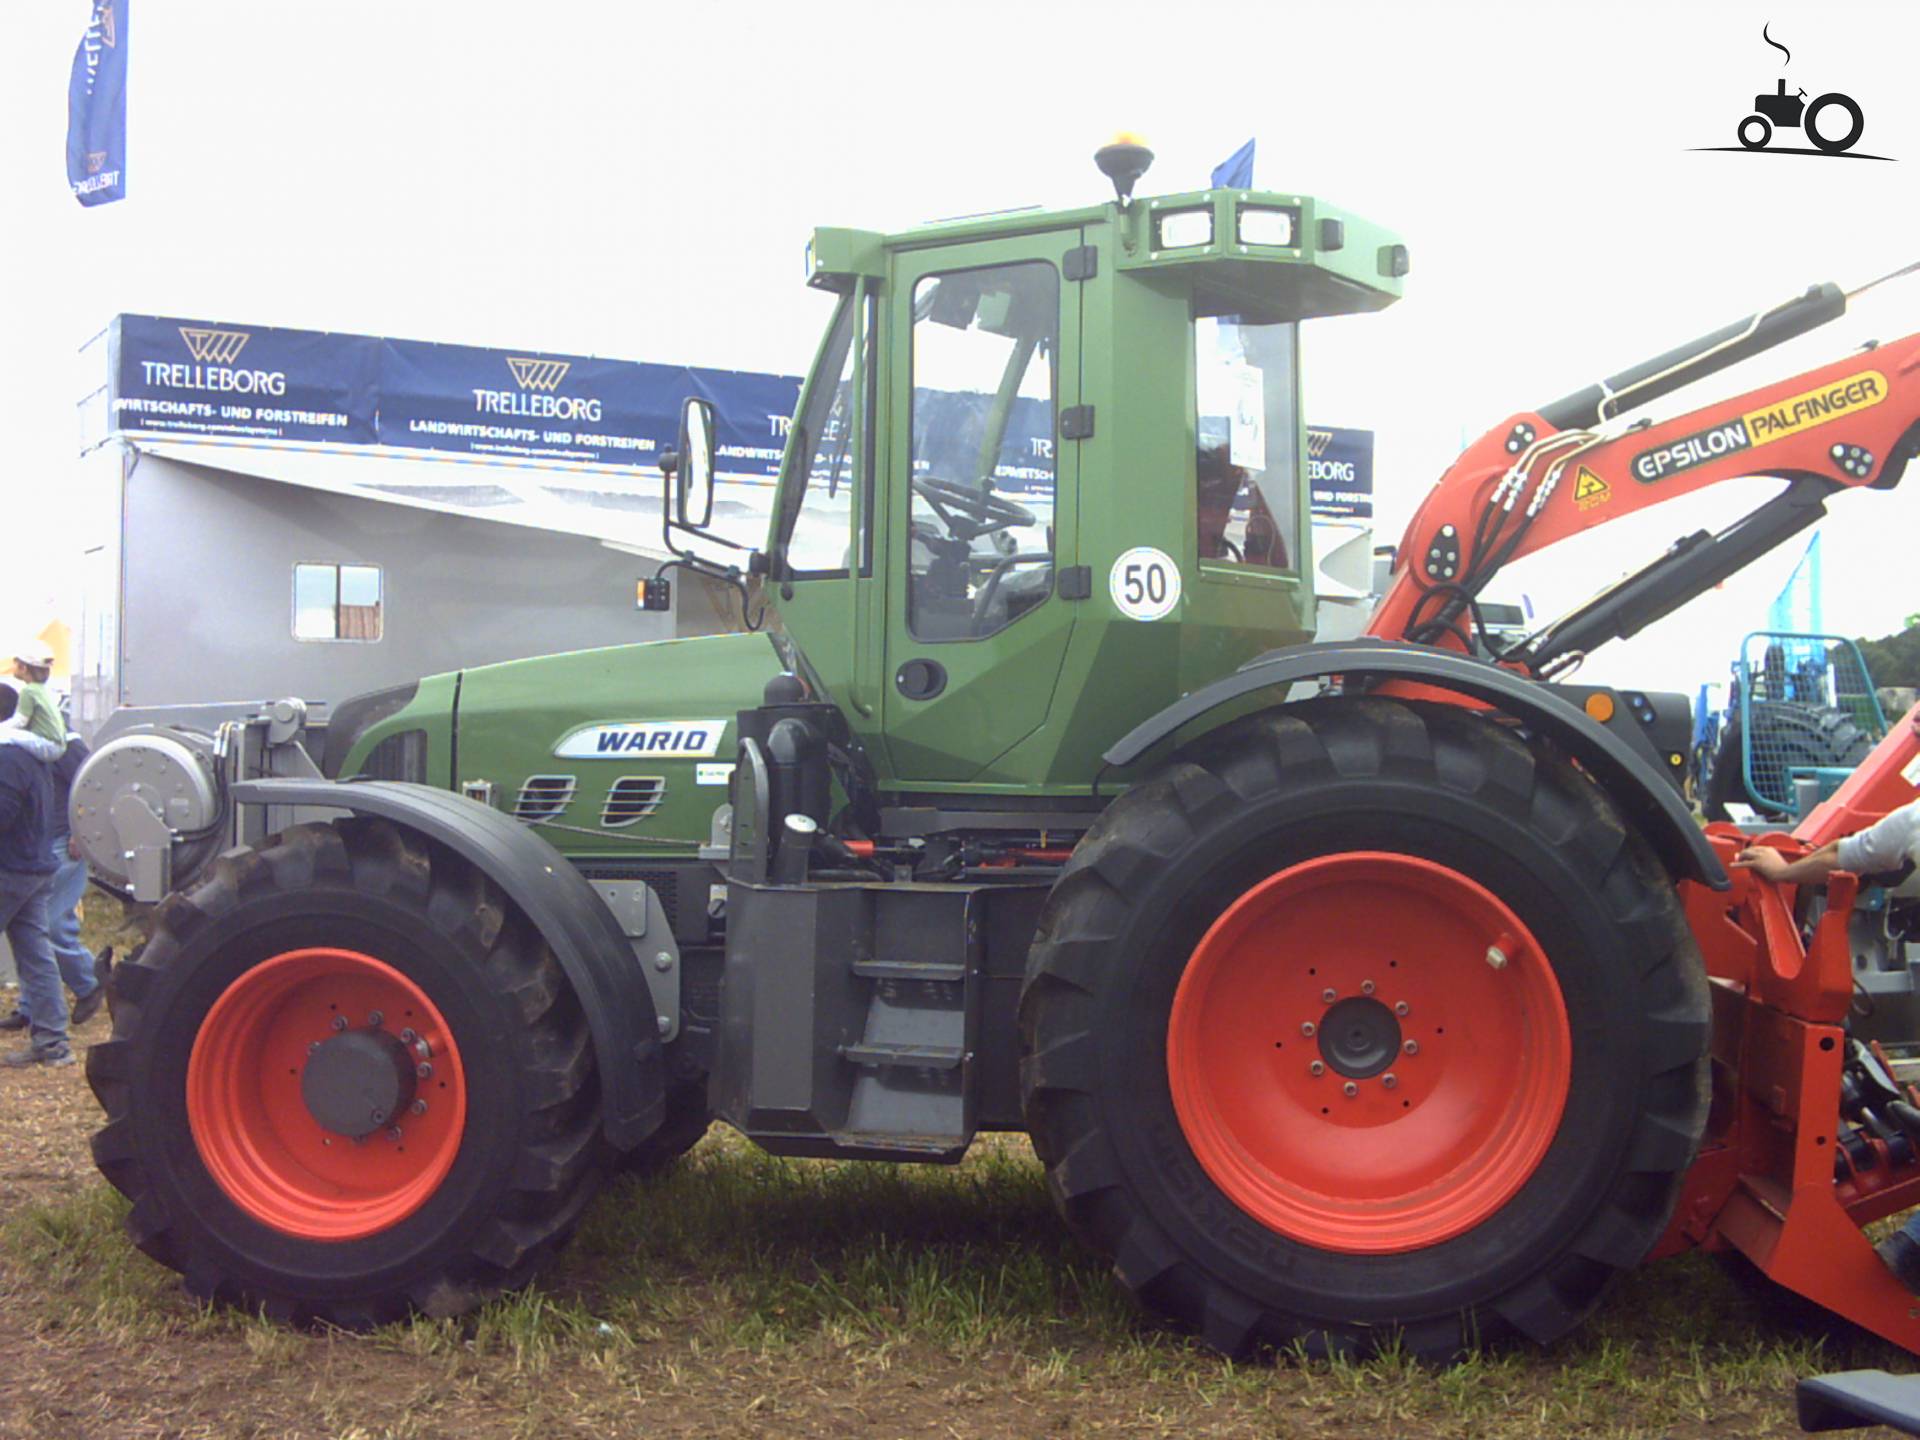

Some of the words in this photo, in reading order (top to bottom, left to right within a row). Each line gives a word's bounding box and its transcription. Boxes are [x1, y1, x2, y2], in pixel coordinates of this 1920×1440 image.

[141, 361, 286, 395] TRELLEBORG
[221, 405, 252, 420] UND
[256, 408, 348, 427] FORSTREIFEN
[472, 389, 602, 422] TRELLEBORG
[543, 432, 572, 445] UND
[1637, 423, 1746, 478] EPSILON
[1750, 377, 1880, 439] PALFINGER
[1125, 563, 1167, 605] 50
[597, 730, 708, 752] WARIO
